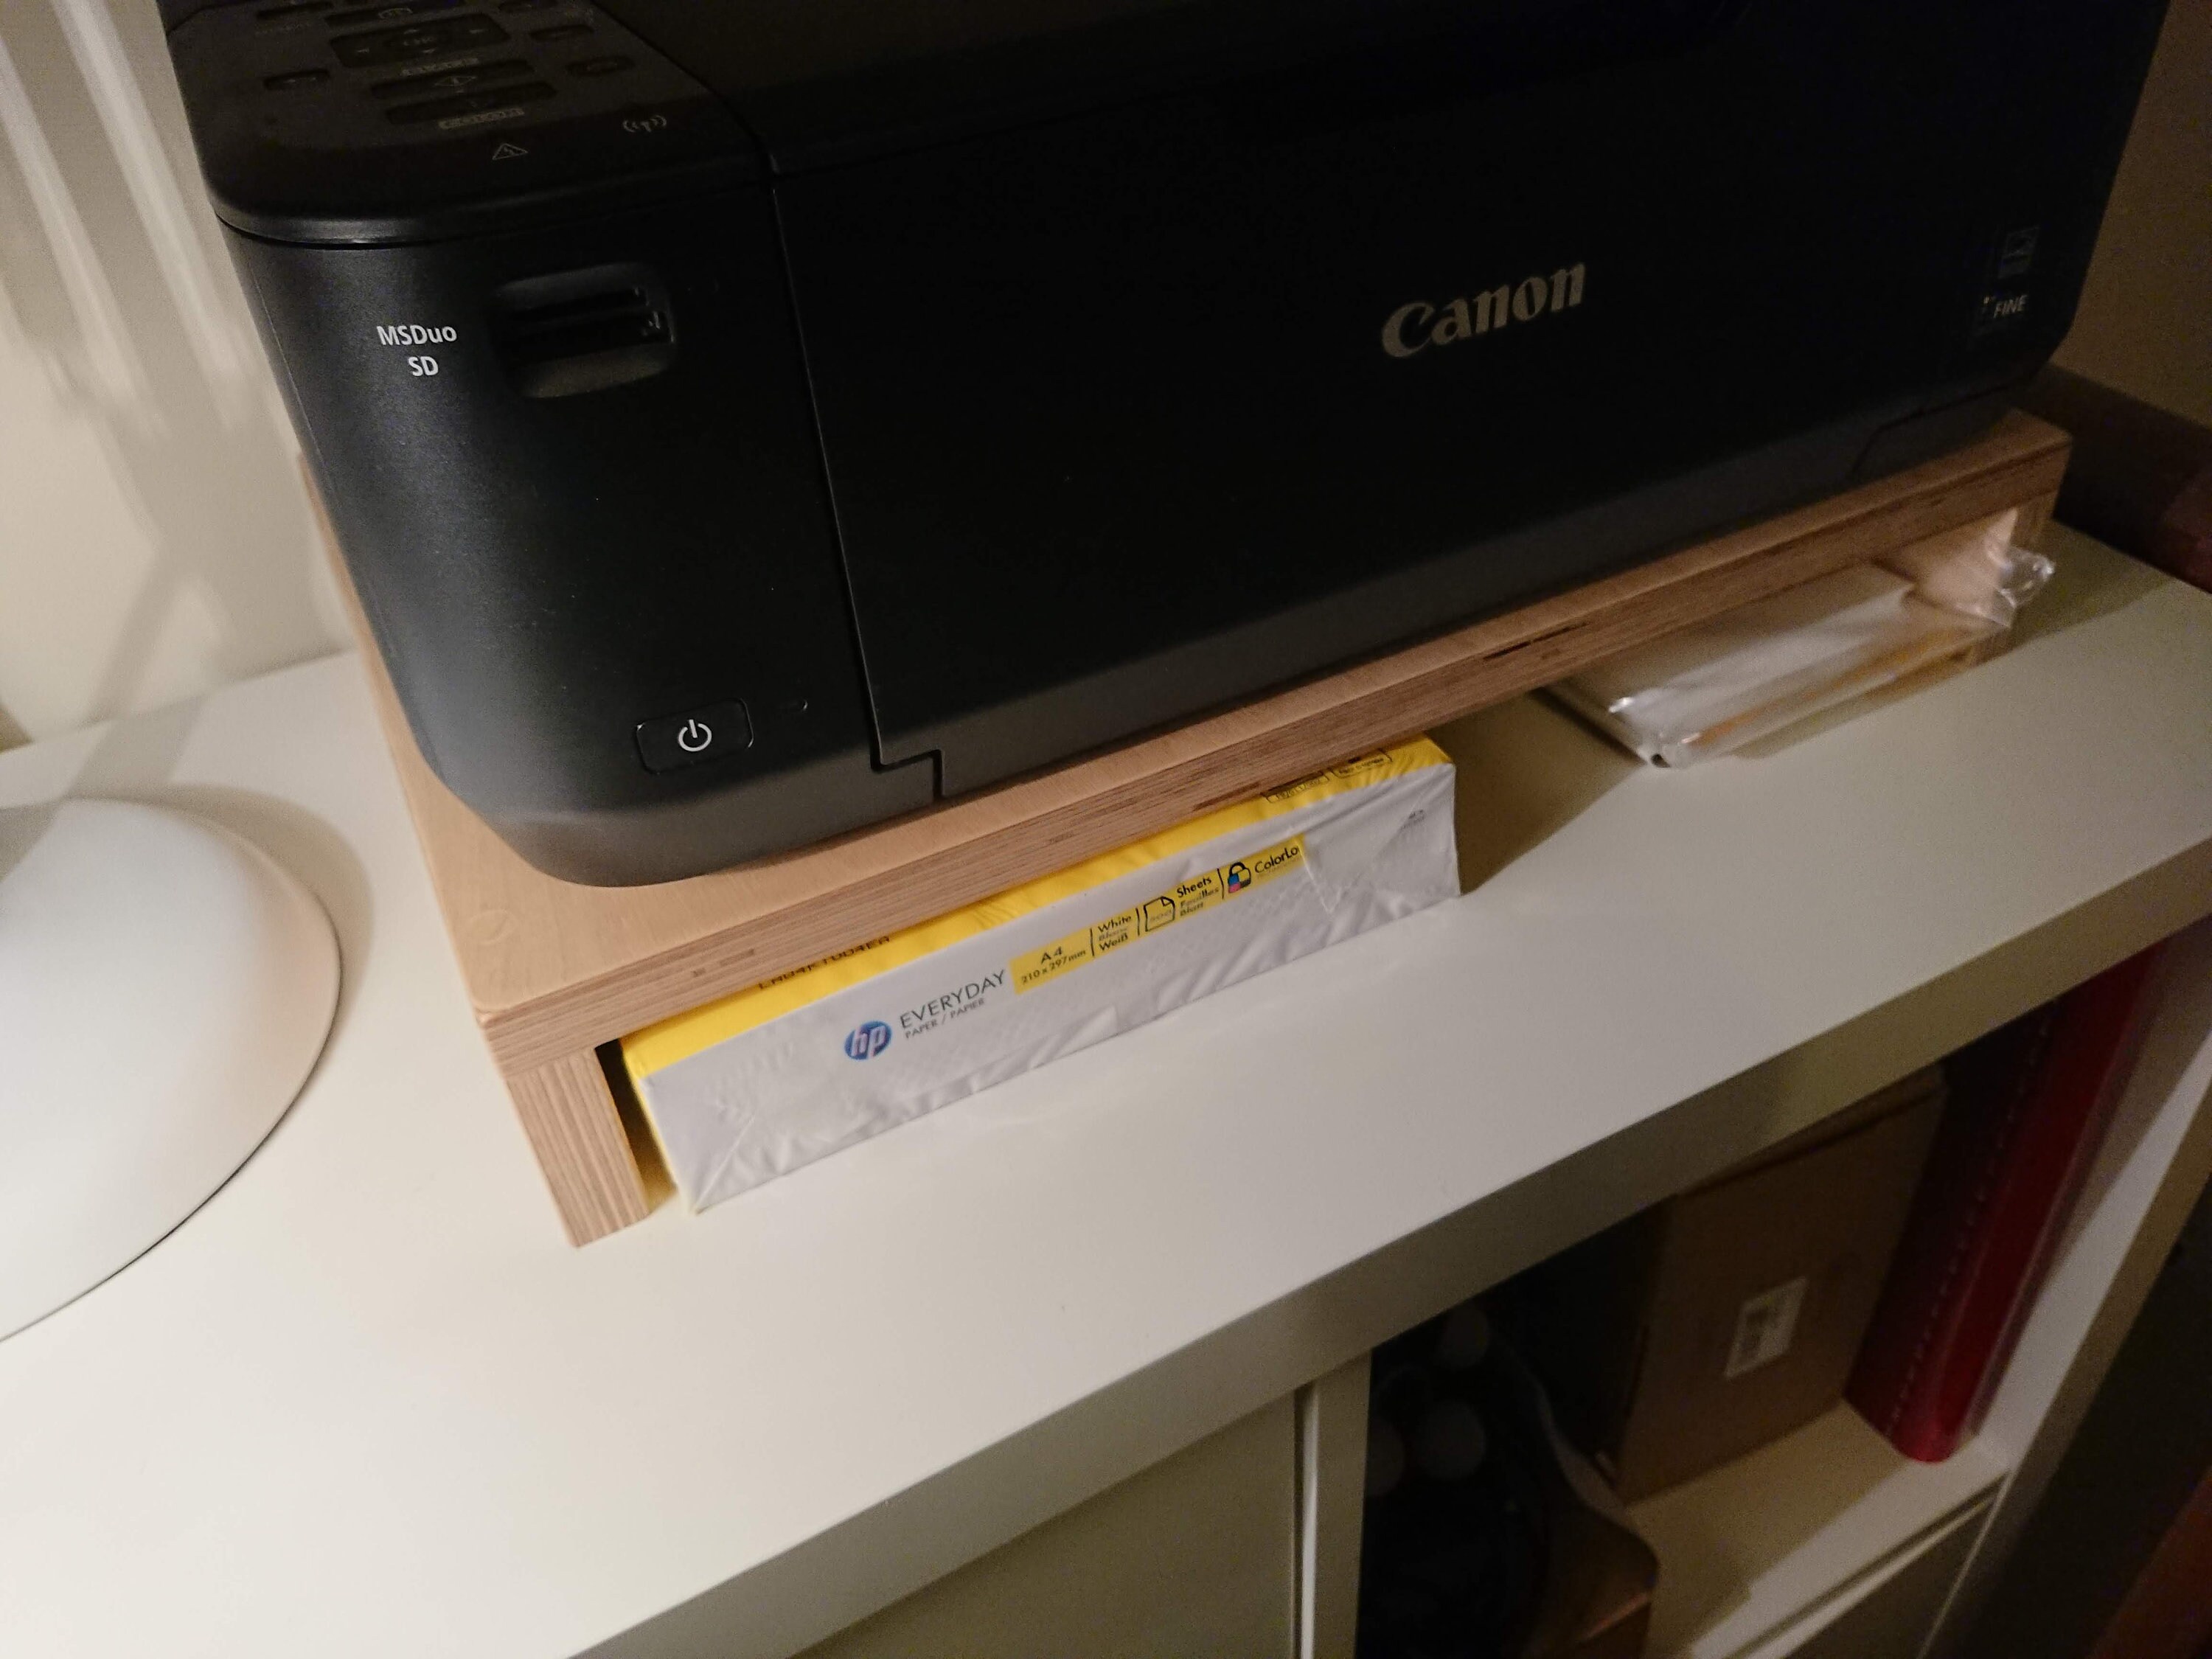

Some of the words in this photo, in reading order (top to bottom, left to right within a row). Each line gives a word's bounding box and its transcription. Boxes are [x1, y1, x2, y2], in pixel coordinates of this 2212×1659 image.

[1381, 262, 1586, 358] Canon
[1994, 293, 2028, 319] FINE
[377, 324, 457, 345] MSDuo
[408, 355, 439, 377] SD
[1177, 876, 1212, 898] Sheets
[1098, 915, 1132, 933] White
[1040, 946, 1063, 964] A4
[1021, 970, 1040, 984] 210
[900, 969, 1005, 1029] EVERYDAY
[905, 1018, 938, 1039] PAPER
[950, 998, 985, 1020] PAPIER
[851, 1025, 886, 1057] hp
